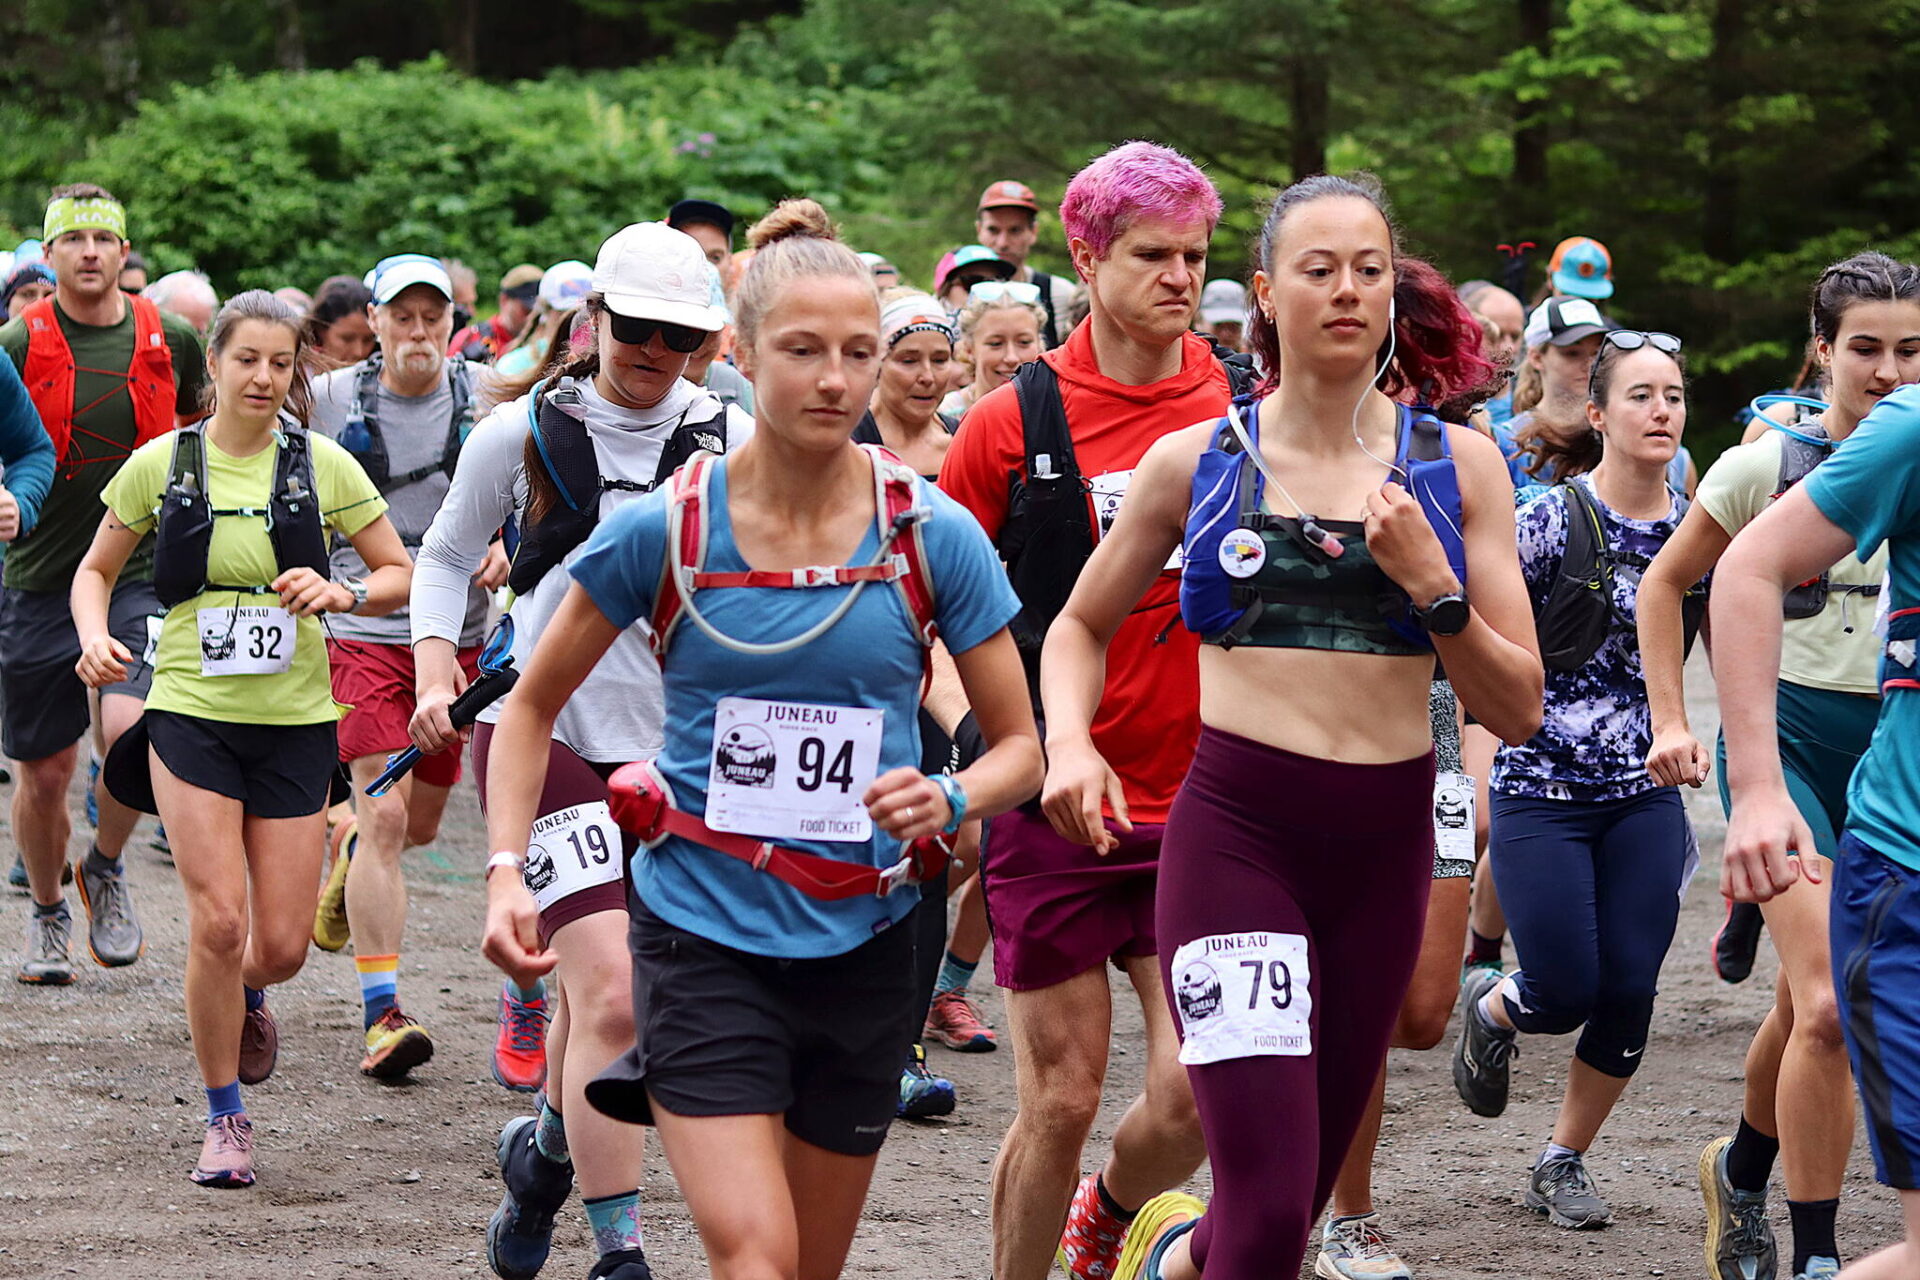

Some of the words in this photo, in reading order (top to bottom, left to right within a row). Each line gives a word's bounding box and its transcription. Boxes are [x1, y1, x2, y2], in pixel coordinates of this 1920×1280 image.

[226, 608, 269, 619] JUNEAU
[248, 625, 282, 660] 32
[765, 705, 838, 724] JUNEAU
[725, 763, 767, 779] JUNEAU
[796, 737, 854, 793] 94
[532, 808, 580, 838] JUNEAU
[800, 820, 825, 833] FOOD
[828, 821, 861, 834] TICKET
[566, 824, 610, 869] 19
[1205, 935, 1268, 956] JUNEAU
[1240, 960, 1292, 1010] 79
[1254, 1035, 1277, 1047] FOOD
[1279, 1035, 1303, 1048] TICKET
